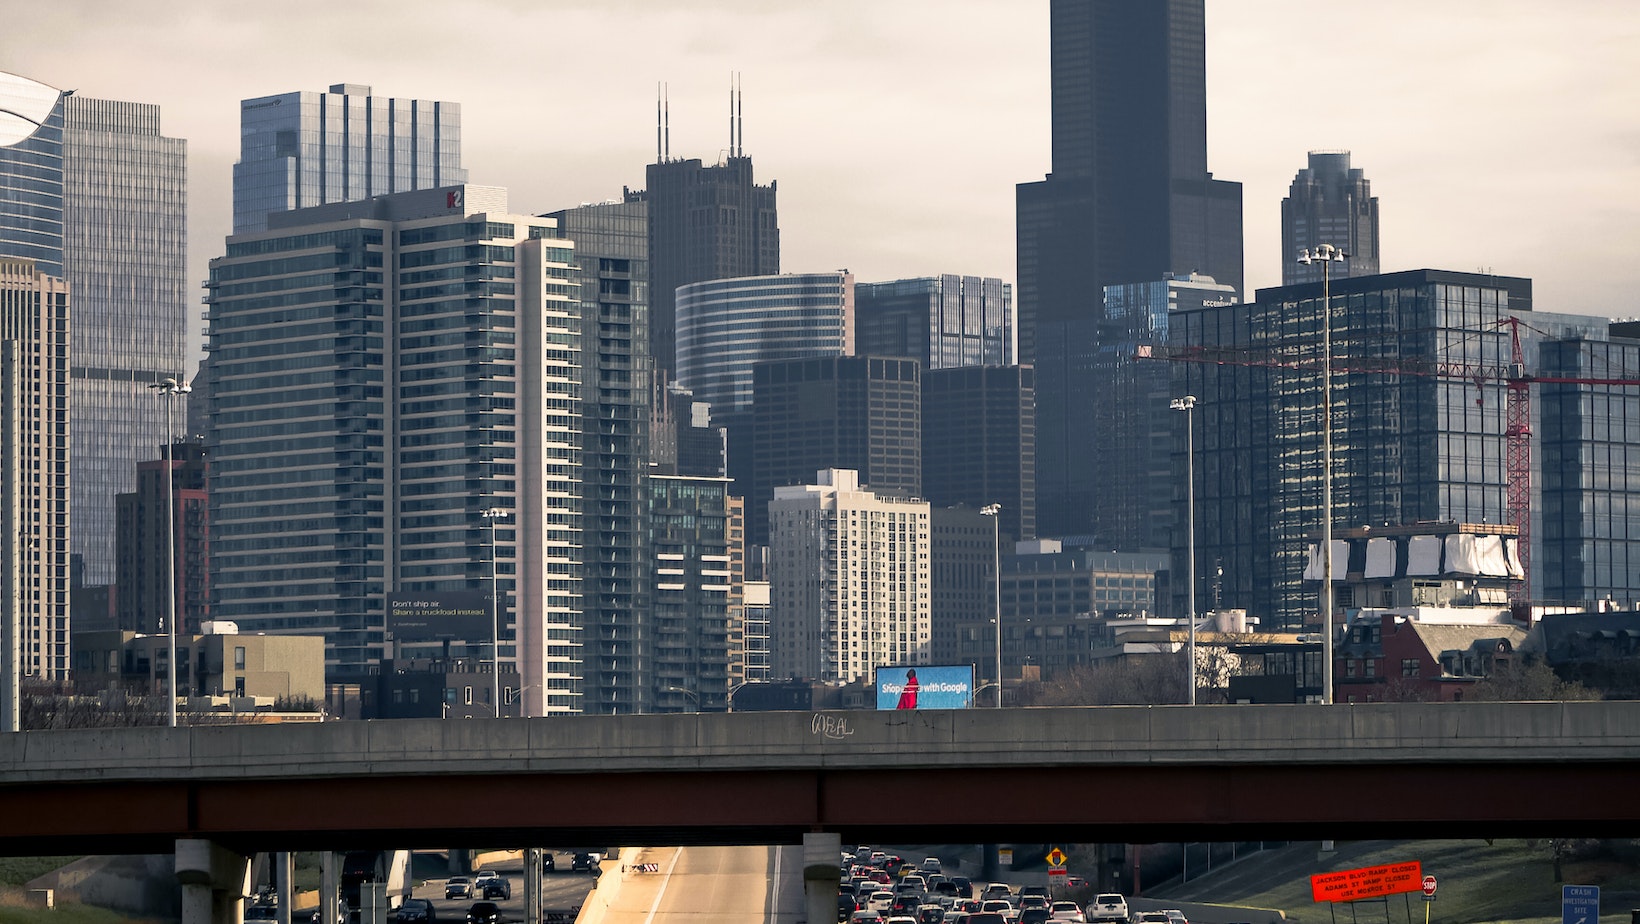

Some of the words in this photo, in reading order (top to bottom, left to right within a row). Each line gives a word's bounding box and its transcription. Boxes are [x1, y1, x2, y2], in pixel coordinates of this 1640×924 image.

[447, 190, 462, 208] K2
[392, 600, 412, 608] Don't
[413, 600, 429, 609] ship
[430, 600, 441, 608] air.
[392, 608, 414, 616] Share
[421, 608, 457, 616] truckload
[882, 683, 900, 695] Shop
[924, 682, 940, 692] with
[940, 682, 967, 694] Google
[1316, 875, 1346, 885] JACKSON
[1349, 872, 1367, 880] BLVD
[1368, 868, 1388, 878] RAMP
[1392, 865, 1417, 874] CLOSED
[1324, 884, 1348, 892] ADAMS
[1351, 881, 1360, 889] ST
[1363, 878, 1381, 886] RAMP
[1385, 874, 1411, 883] CLOSED
[1423, 882, 1437, 890] STOP
[1341, 890, 1354, 898] USE
[1357, 886, 1383, 895] MONROE
[1570, 888, 1592, 896] CRASH
[1564, 897, 1598, 905] INVESTIGATION
